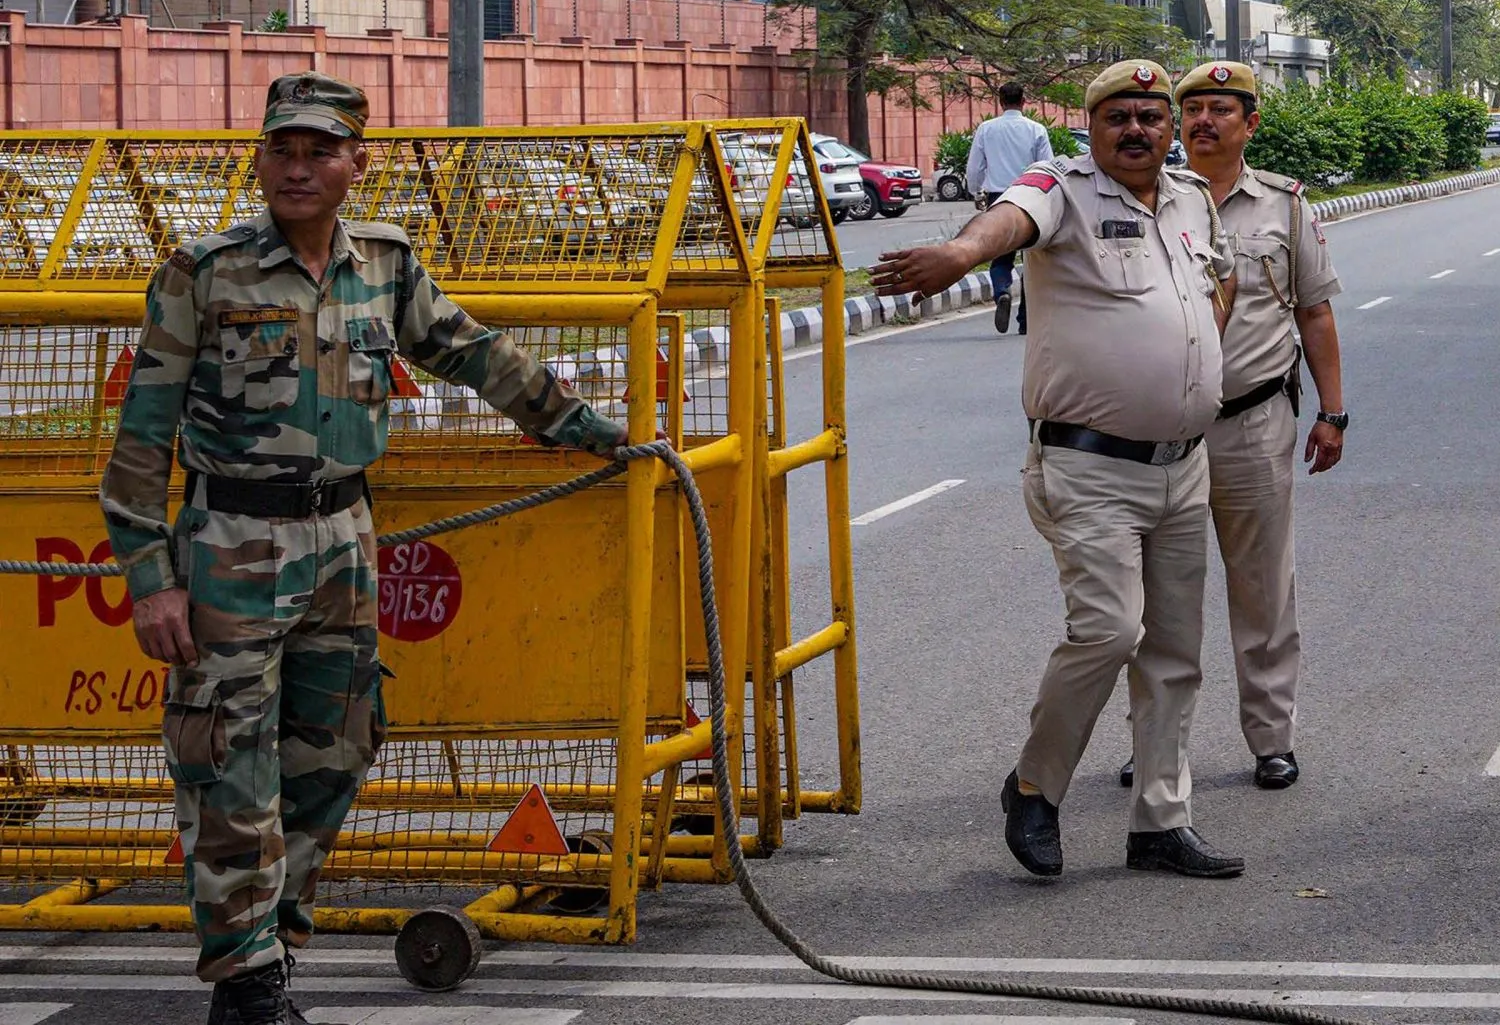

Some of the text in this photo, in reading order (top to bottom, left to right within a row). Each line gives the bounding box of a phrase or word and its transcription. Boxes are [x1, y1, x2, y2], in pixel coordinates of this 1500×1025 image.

[389, 541, 431, 574] SD
[35, 537, 134, 627] PO
[117, 667, 170, 713] LO
